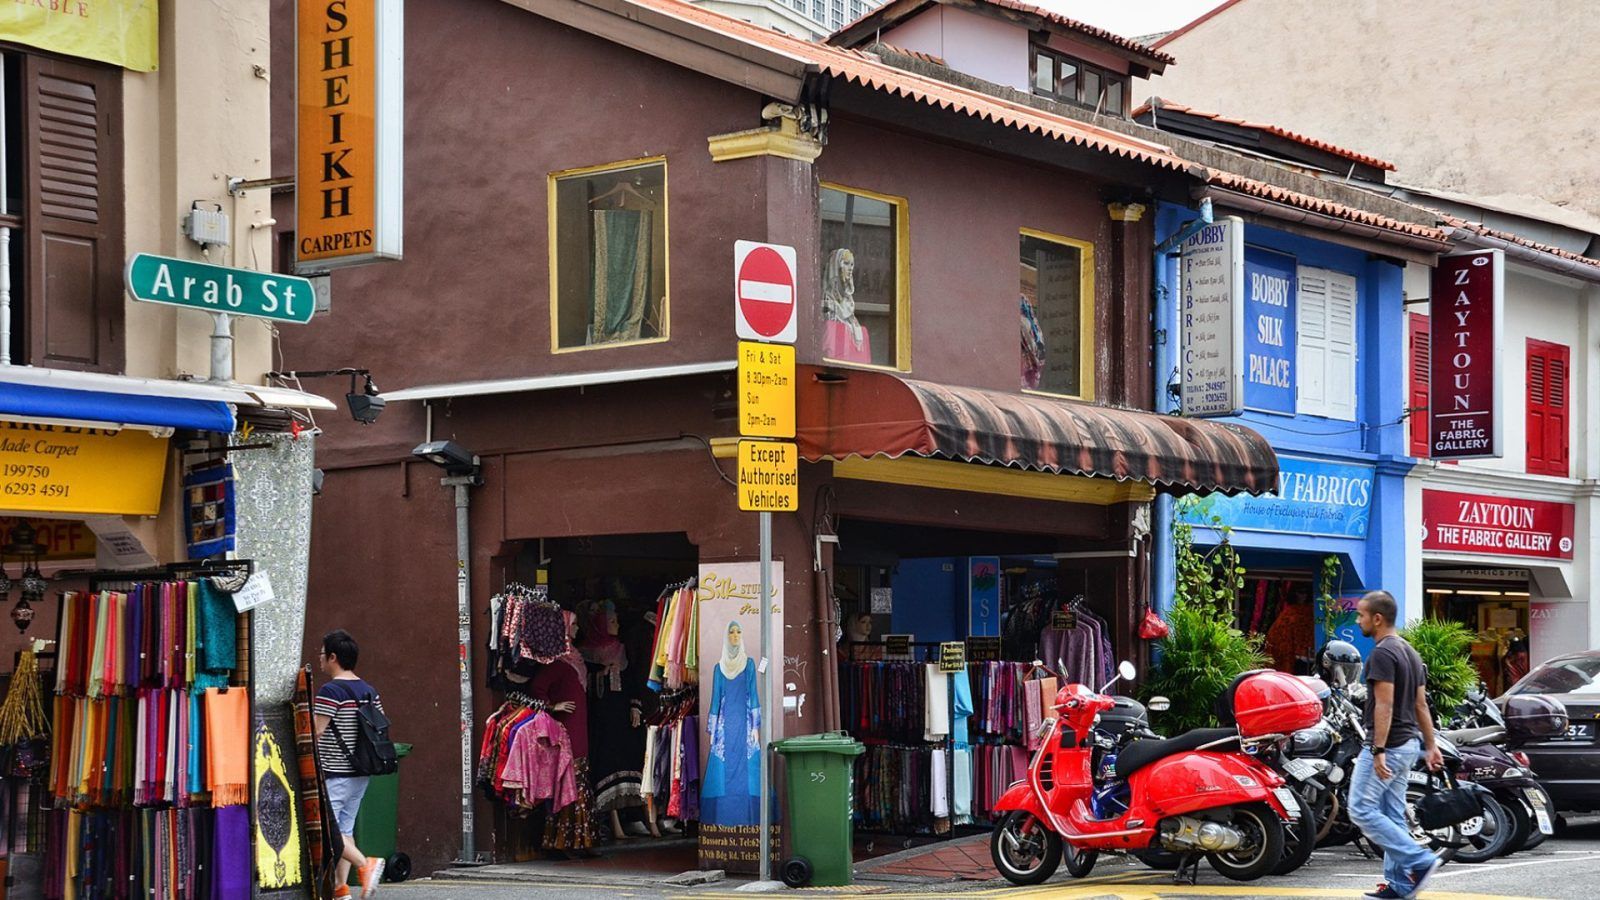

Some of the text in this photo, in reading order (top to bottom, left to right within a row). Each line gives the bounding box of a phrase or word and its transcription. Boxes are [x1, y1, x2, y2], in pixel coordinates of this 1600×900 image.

[320, 0, 354, 219] SHEIKH
[301, 230, 372, 254] CARPETS
[152, 263, 296, 316] Arab St
[1252, 272, 1290, 308] BOBBY
[1185, 259, 1194, 382] FABRICS
[1257, 314, 1284, 347] SILK
[1453, 269, 1471, 411] ZAYTOUN
[746, 350, 782, 365] Fri & Sat
[1249, 354, 1290, 388] PALACE
[747, 392, 760, 405] Sun
[747, 413, 776, 427] 2pm-2am
[1450, 420, 1474, 429] THE
[1440, 429, 1485, 441] FABRIC
[34, 440, 80, 459] Carpet
[1435, 439, 1489, 451] GALLERY
[751, 444, 786, 467] Except
[4, 463, 50, 478] 199750
[740, 467, 797, 486] Authorised
[4, 482, 70, 497] 6293 4591
[747, 489, 790, 508] Vehicles
[1292, 472, 1370, 507] FABRICS
[1243, 502, 1265, 515] House
[1458, 500, 1535, 529] ZAYTOUN
[1437, 527, 1459, 544] THE
[1462, 530, 1503, 547] FABRIC
[1505, 533, 1552, 551] GALLERY
[1460, 568, 1505, 578] FABRICS
[699, 571, 748, 602] Silk
[703, 824, 717, 832] Arab
[719, 825, 737, 833] Street
